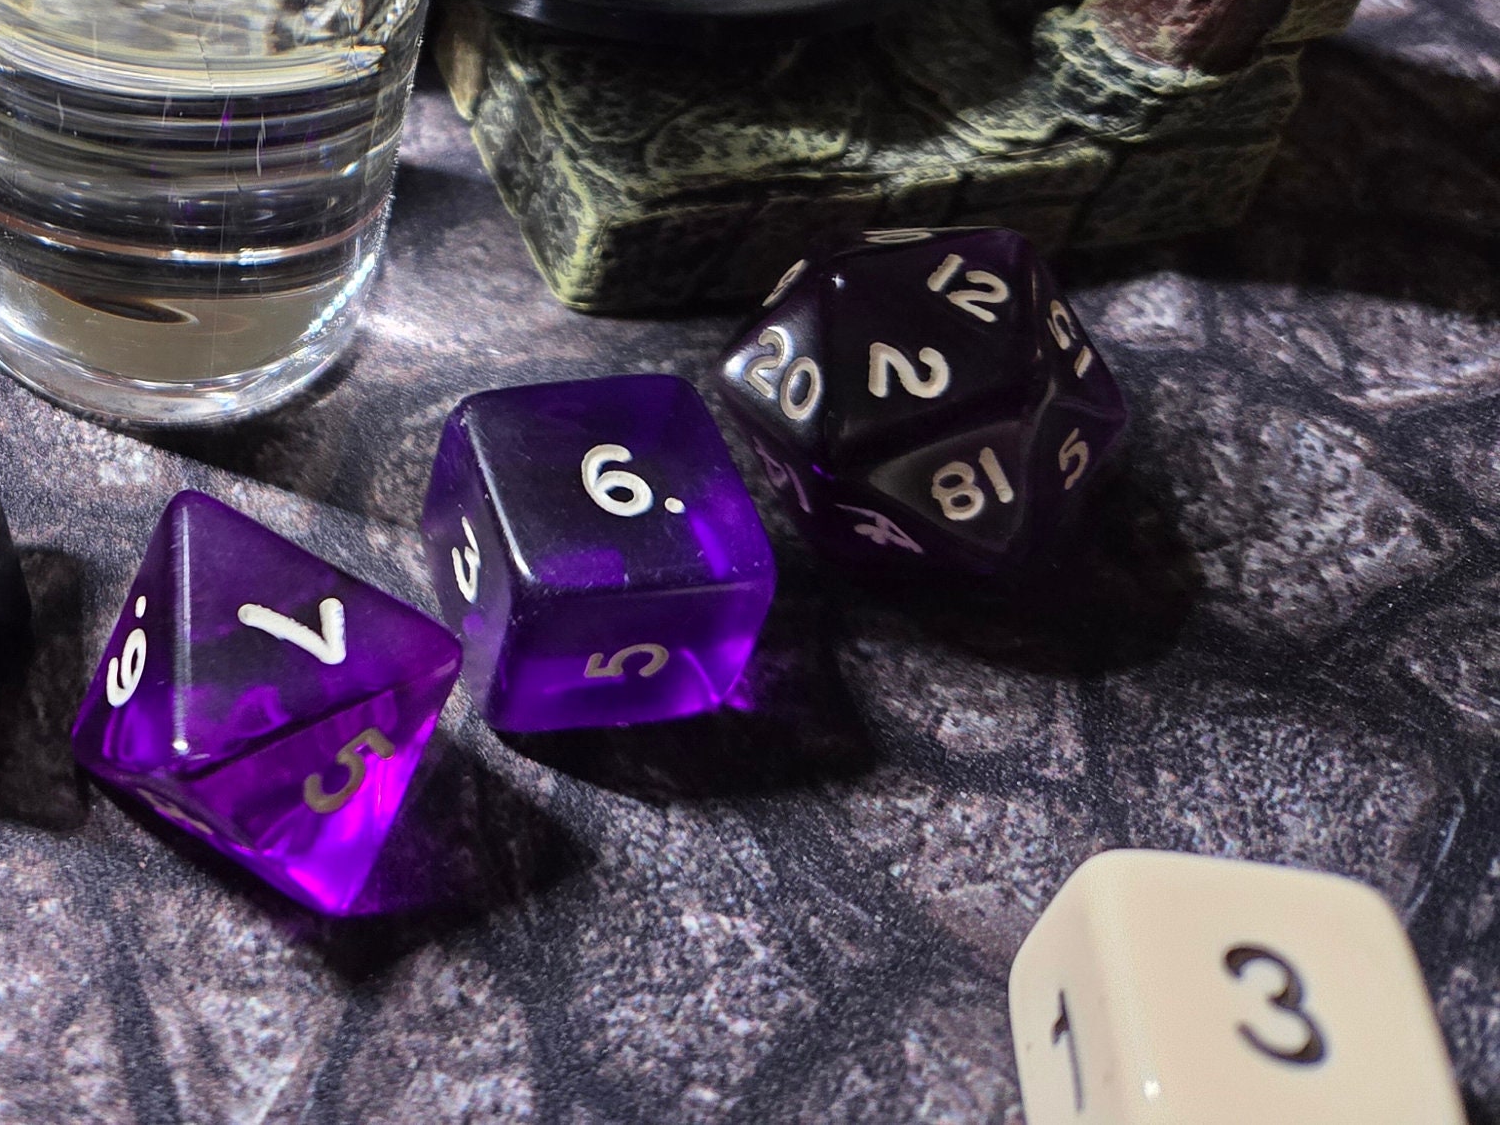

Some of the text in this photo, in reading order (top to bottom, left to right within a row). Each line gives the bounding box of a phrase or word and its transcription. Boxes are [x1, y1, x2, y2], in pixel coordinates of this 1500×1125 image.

[927, 253, 1010, 323] 12
[742, 325, 822, 420] 20
[868, 341, 949, 399] 2
[237, 597, 346, 665] 7
[583, 642, 670, 678] 5
[303, 727, 395, 814] 5
[1223, 942, 1332, 1067] 3
[1051, 989, 1084, 1113] 1
